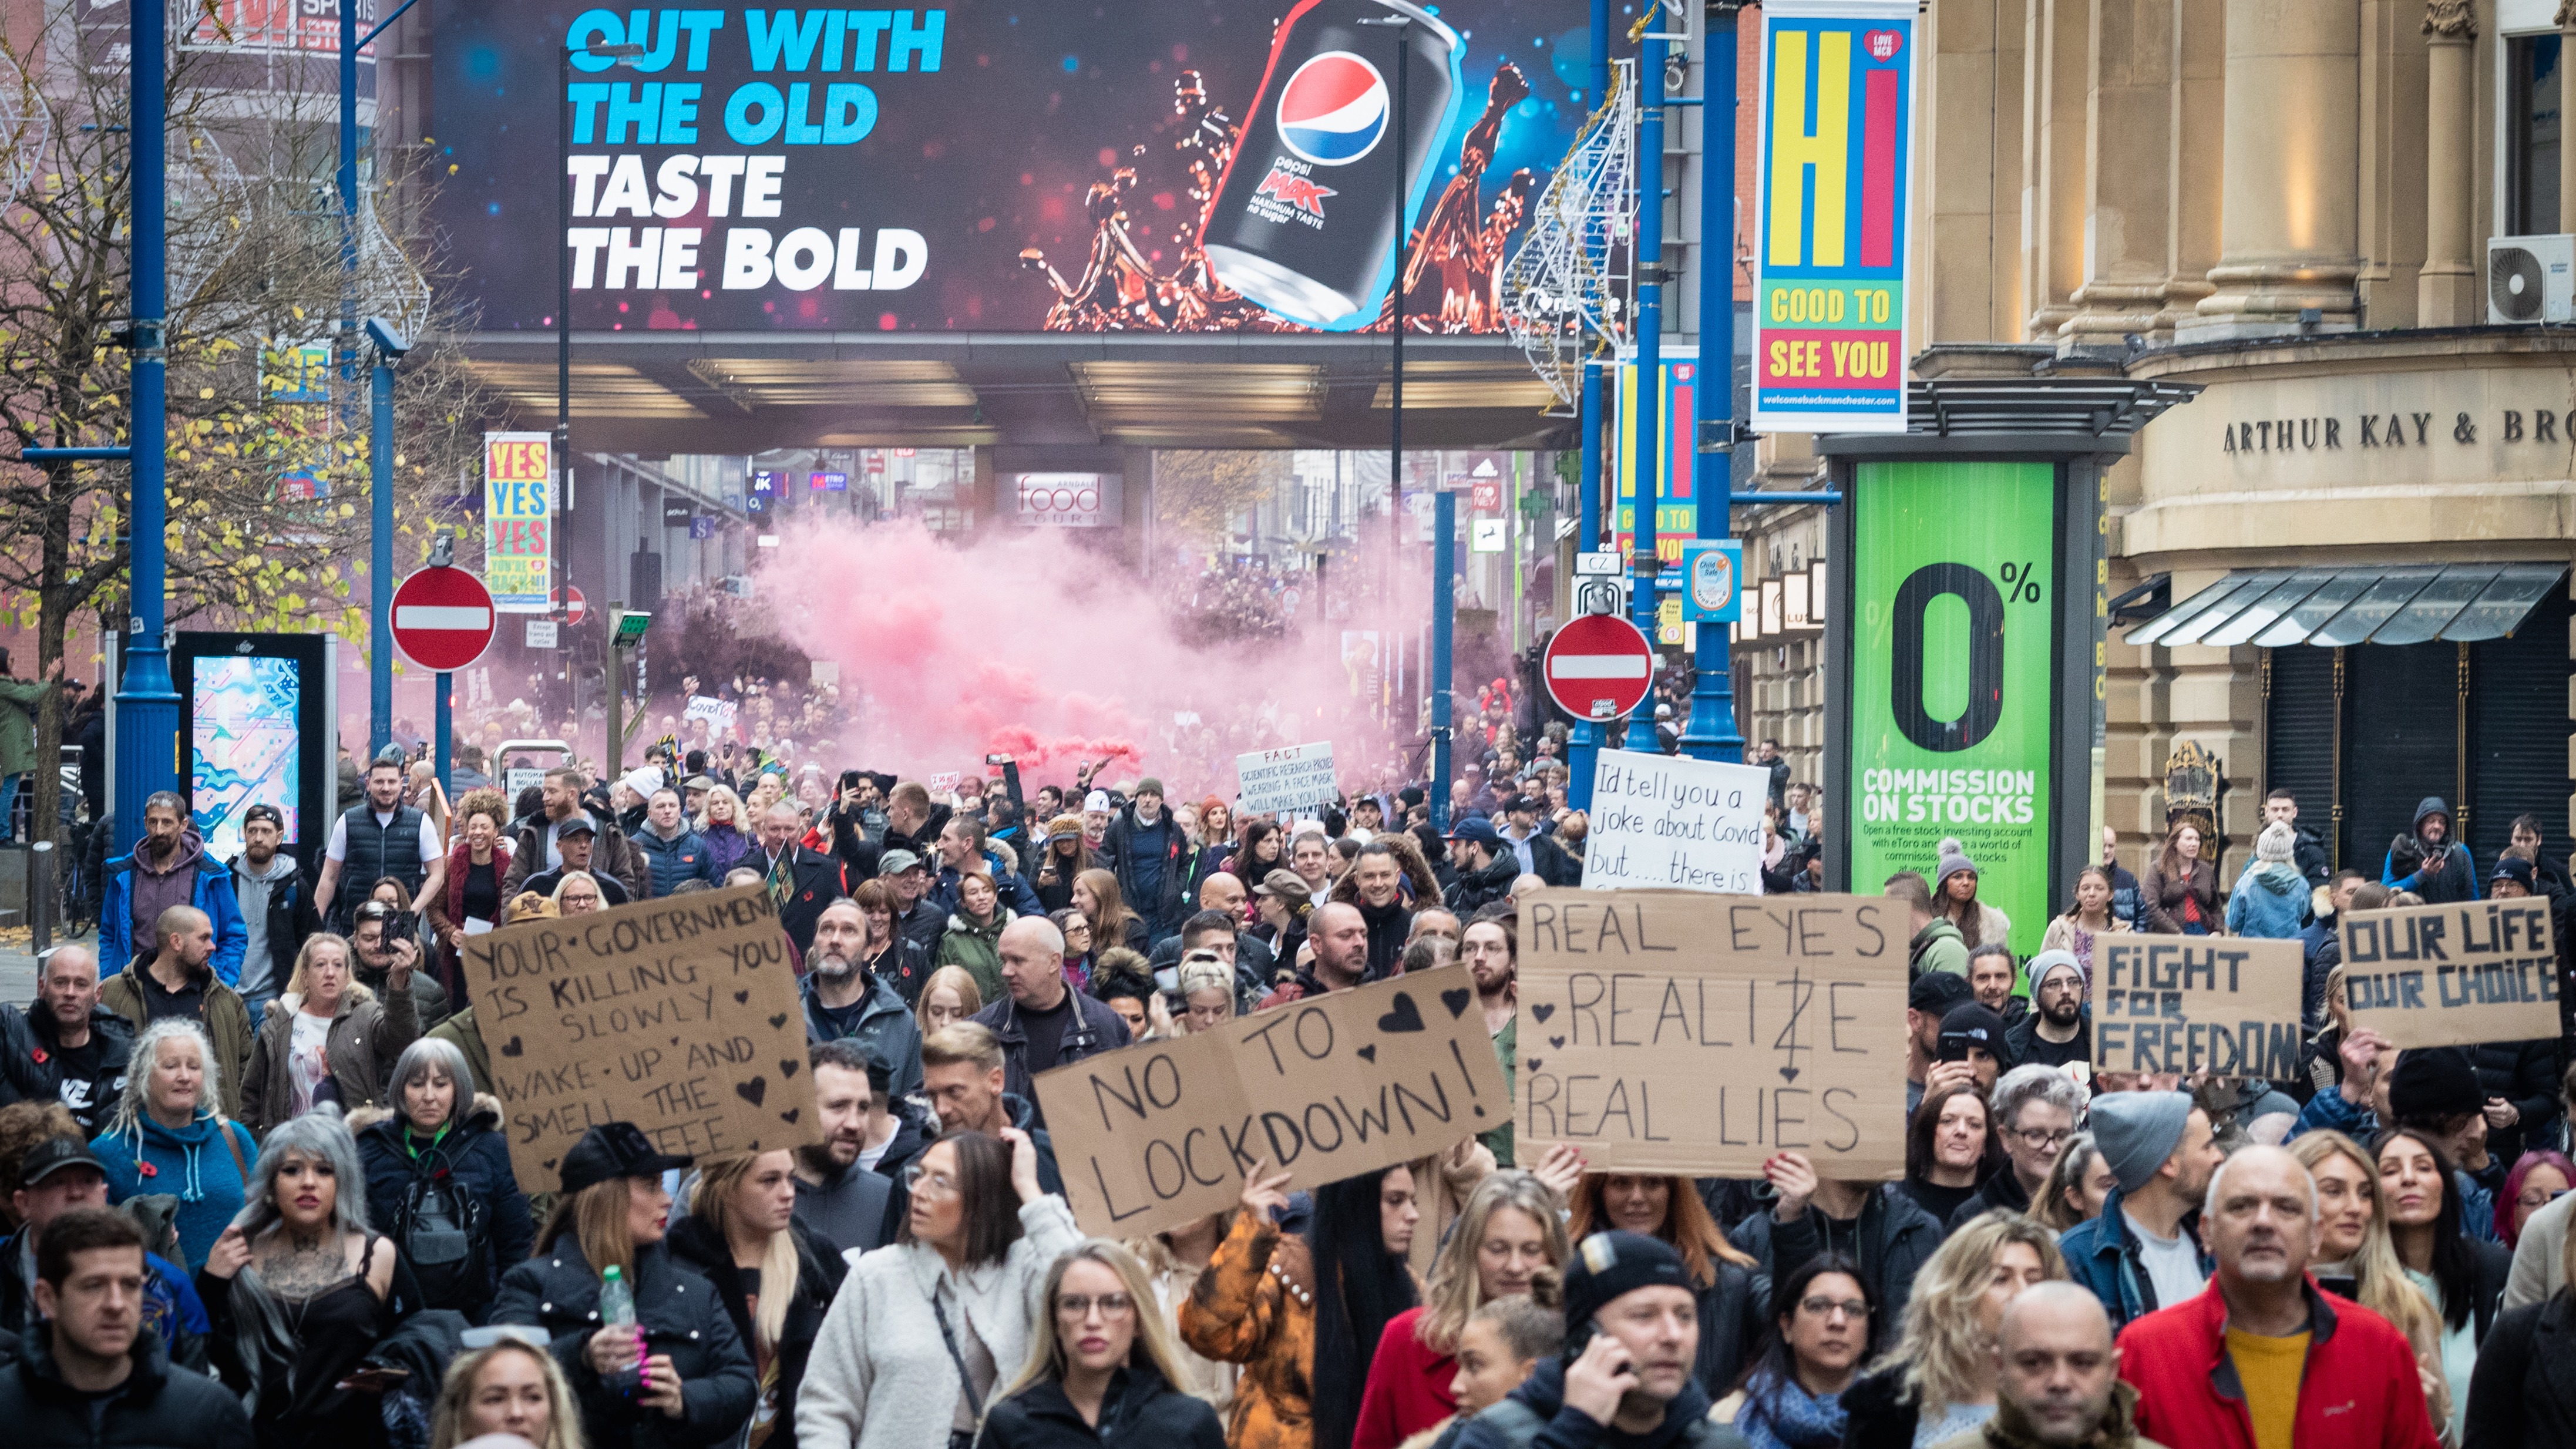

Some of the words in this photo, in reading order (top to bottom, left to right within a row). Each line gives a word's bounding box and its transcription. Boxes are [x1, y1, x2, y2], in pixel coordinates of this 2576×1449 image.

[567, 9, 724, 73] OUT
[746, 9, 947, 73] WITH
[1873, 35, 1893, 46] LOVE
[567, 82, 702, 145] THE
[724, 81, 879, 146] OLD
[1273, 156, 1313, 177] pepsi
[567, 154, 787, 218] TASTE
[1256, 167, 1339, 220] MAX
[1246, 204, 1260, 214] no
[1259, 207, 1290, 224] sugar
[1250, 195, 1296, 218] MAXIMUM
[1296, 210, 1324, 231] TASTE
[567, 227, 702, 290] THE
[722, 227, 929, 291] BOLD
[1770, 287, 1845, 324] GOOD
[1854, 288, 1890, 324] TO
[1770, 339, 1822, 378] SEE
[1831, 340, 1889, 379] YOU
[1763, 393, 1896, 406] welcomebackmanchester.com
[2223, 417, 2342, 452] ARTHUR
[2360, 412, 2431, 447] KAY
[2453, 412, 2477, 445] &
[492, 443, 547, 479] YES
[492, 482, 546, 516] YES
[1018, 475, 1101, 513] food
[492, 520, 546, 554] YES
[1669, 509, 1690, 530] TO
[1589, 557, 1609, 571] CZ
[1699, 560, 1716, 569] Child
[1242, 765, 1279, 782] SCIENTIFIC
[1280, 760, 1312, 777] RESEARCH
[1264, 747, 1301, 763] FACT
[1246, 779, 1281, 796] WEARING
[1284, 779, 1290, 791] A
[1293, 774, 1310, 789] FACE
[1311, 771, 1334, 786] MASK
[1246, 797, 1270, 812] WILL
[1271, 793, 1294, 809] MAKE
[1296, 789, 1316, 805] YOU
[1626, 769, 1668, 801] tell
[1671, 785, 1719, 810] you
[1728, 789, 1743, 809] a
[1864, 768, 2034, 795] COMMISSION
[1593, 805, 1644, 835] joke
[1654, 810, 1706, 841] about
[1713, 815, 1761, 845] Covid
[1863, 794, 1899, 822] ON
[1906, 795, 2034, 824] STOCKS
[1863, 824, 1884, 836] Open
[1892, 825, 1912, 835] free
[1914, 825, 1941, 835] stock
[1943, 826, 1991, 838] investing
[1993, 827, 2033, 838] account
[1872, 836, 1889, 847] with
[1891, 837, 1919, 848] eToro
[1979, 840, 2009, 850] world
[2012, 839, 2022, 850] of
[1669, 850, 1724, 887] there
[1730, 869, 1749, 891] is
[1973, 852, 2007, 863] stocks
[469, 931, 571, 981] YOUR
[586, 894, 778, 957] GOVERNMENT
[1532, 902, 1678, 955] REAL
[1729, 905, 1886, 958] EYES
[2346, 915, 2449, 963] OUR
[485, 985, 529, 1021] IS
[549, 954, 699, 1010] KILLING
[718, 939, 783, 974] YOU
[2346, 970, 2427, 1012] OUR
[561, 985, 715, 1044] SLOWLY
[1568, 968, 1869, 1057] REALIZE
[2106, 989, 2188, 1026] FOR
[498, 1062, 597, 1103] WAKE
[621, 1046, 663, 1081] UP
[687, 1035, 755, 1071] AND
[1088, 1054, 1182, 1131] NO
[1242, 1006, 1334, 1075] TO
[2097, 1020, 2301, 1082] FREEDOM
[643, 1077, 719, 1115] THE
[1527, 1073, 1670, 1142] REAL
[1719, 1087, 1860, 1153] LIES
[1090, 1039, 1487, 1223] LOCKDOWN!
